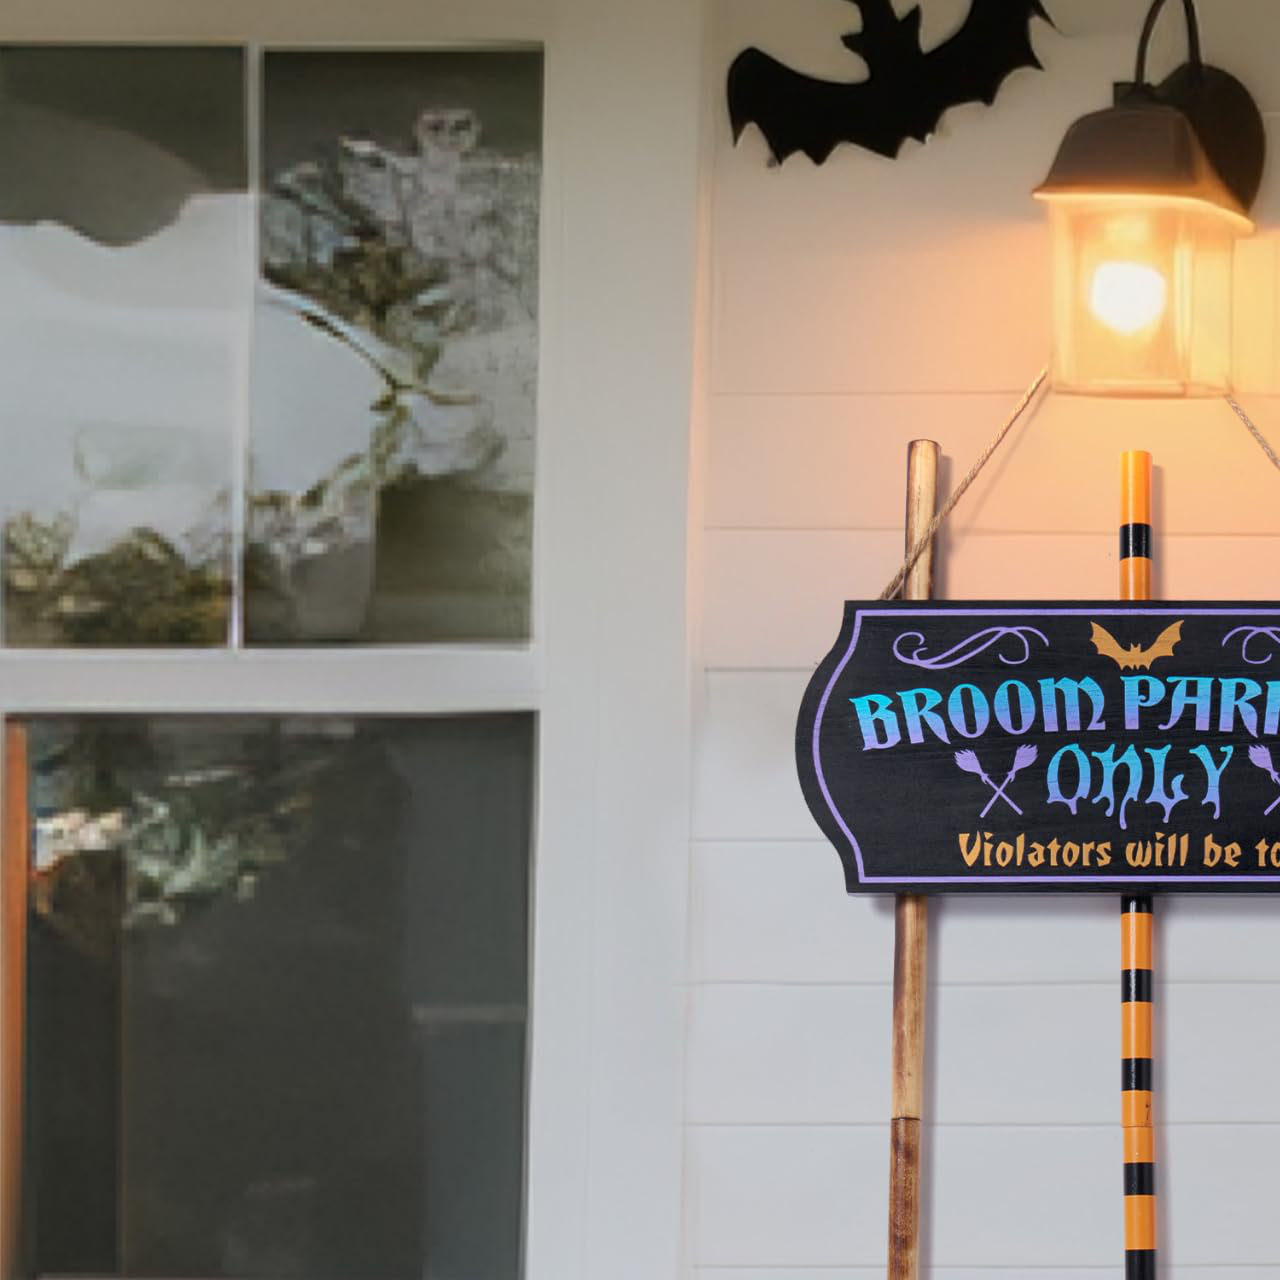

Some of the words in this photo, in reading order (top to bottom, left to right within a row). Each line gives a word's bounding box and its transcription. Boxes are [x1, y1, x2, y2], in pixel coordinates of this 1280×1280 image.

[848, 675, 1106, 752] BROOM
[1046, 743, 1234, 830] ONLY
[958, 830, 1112, 868] Violators
[1125, 831, 1189, 868] will
[1203, 833, 1242, 868] be
